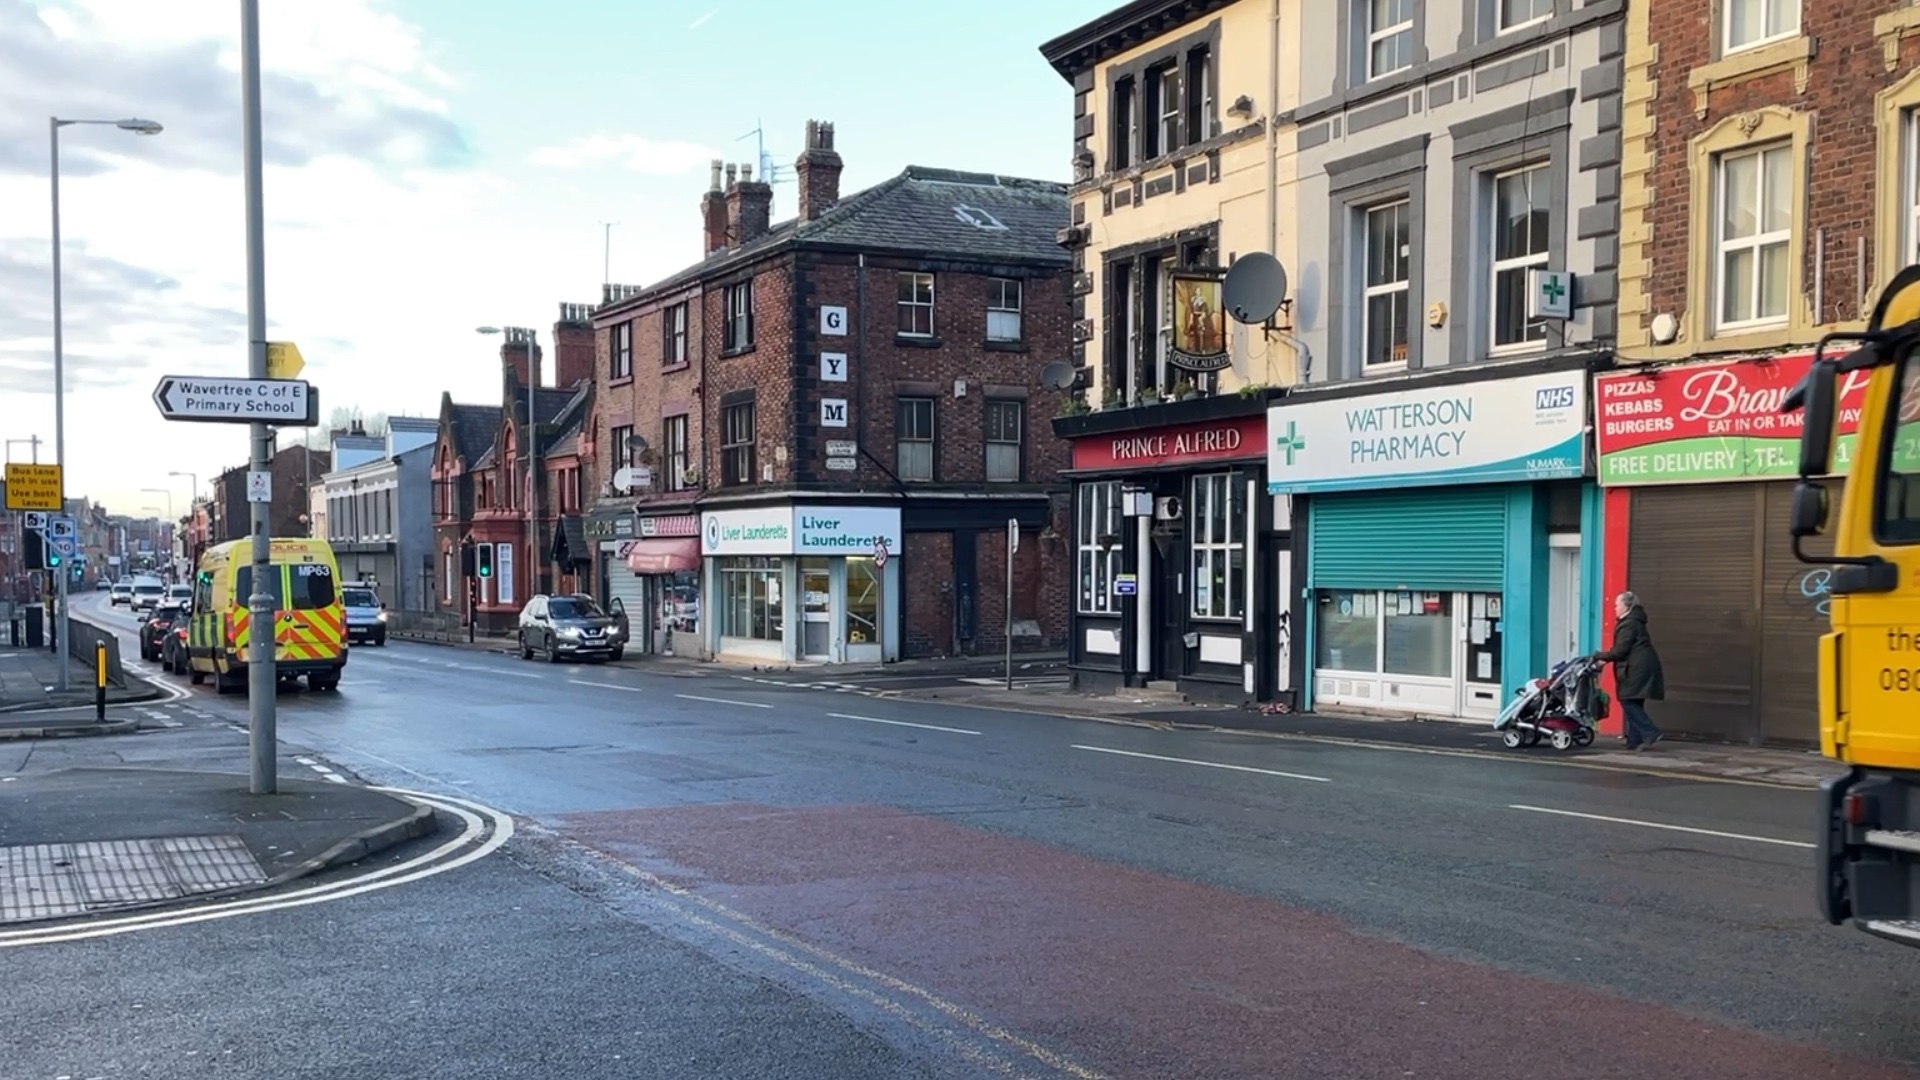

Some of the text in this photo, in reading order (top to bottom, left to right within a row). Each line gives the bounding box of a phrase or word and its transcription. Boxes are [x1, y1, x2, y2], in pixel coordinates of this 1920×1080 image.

[179, 381, 301, 398] Wavertree C of E
[1604, 380, 1656, 398] PIZZAS
[186, 397, 295, 413] Primary School
[1537, 388, 1572, 408] NHS
[1346, 397, 1472, 432] WATTERSON
[1605, 398, 1663, 416] KEBABS
[1606, 417, 1675, 435] BURGERS
[1707, 419, 1732, 433] EAT
[1735, 417, 1750, 431] IN
[1753, 414, 1775, 429] OR
[1112, 428, 1240, 459] PRINCE ALFRED
[1351, 430, 1466, 464] PHARMACY
[12, 467, 56, 475] Bus lane
[1526, 457, 1566, 469] NUMARK
[1609, 456, 1649, 475] FREE
[1653, 450, 1737, 473] DELIVERY
[29, 477, 38, 485] in
[11, 489, 57, 498] Use both
[22, 499, 49, 507] lanes
[801, 516, 841, 530] Liver
[721, 524, 788, 541] Liver Launderette
[298, 566, 330, 576] MP63
